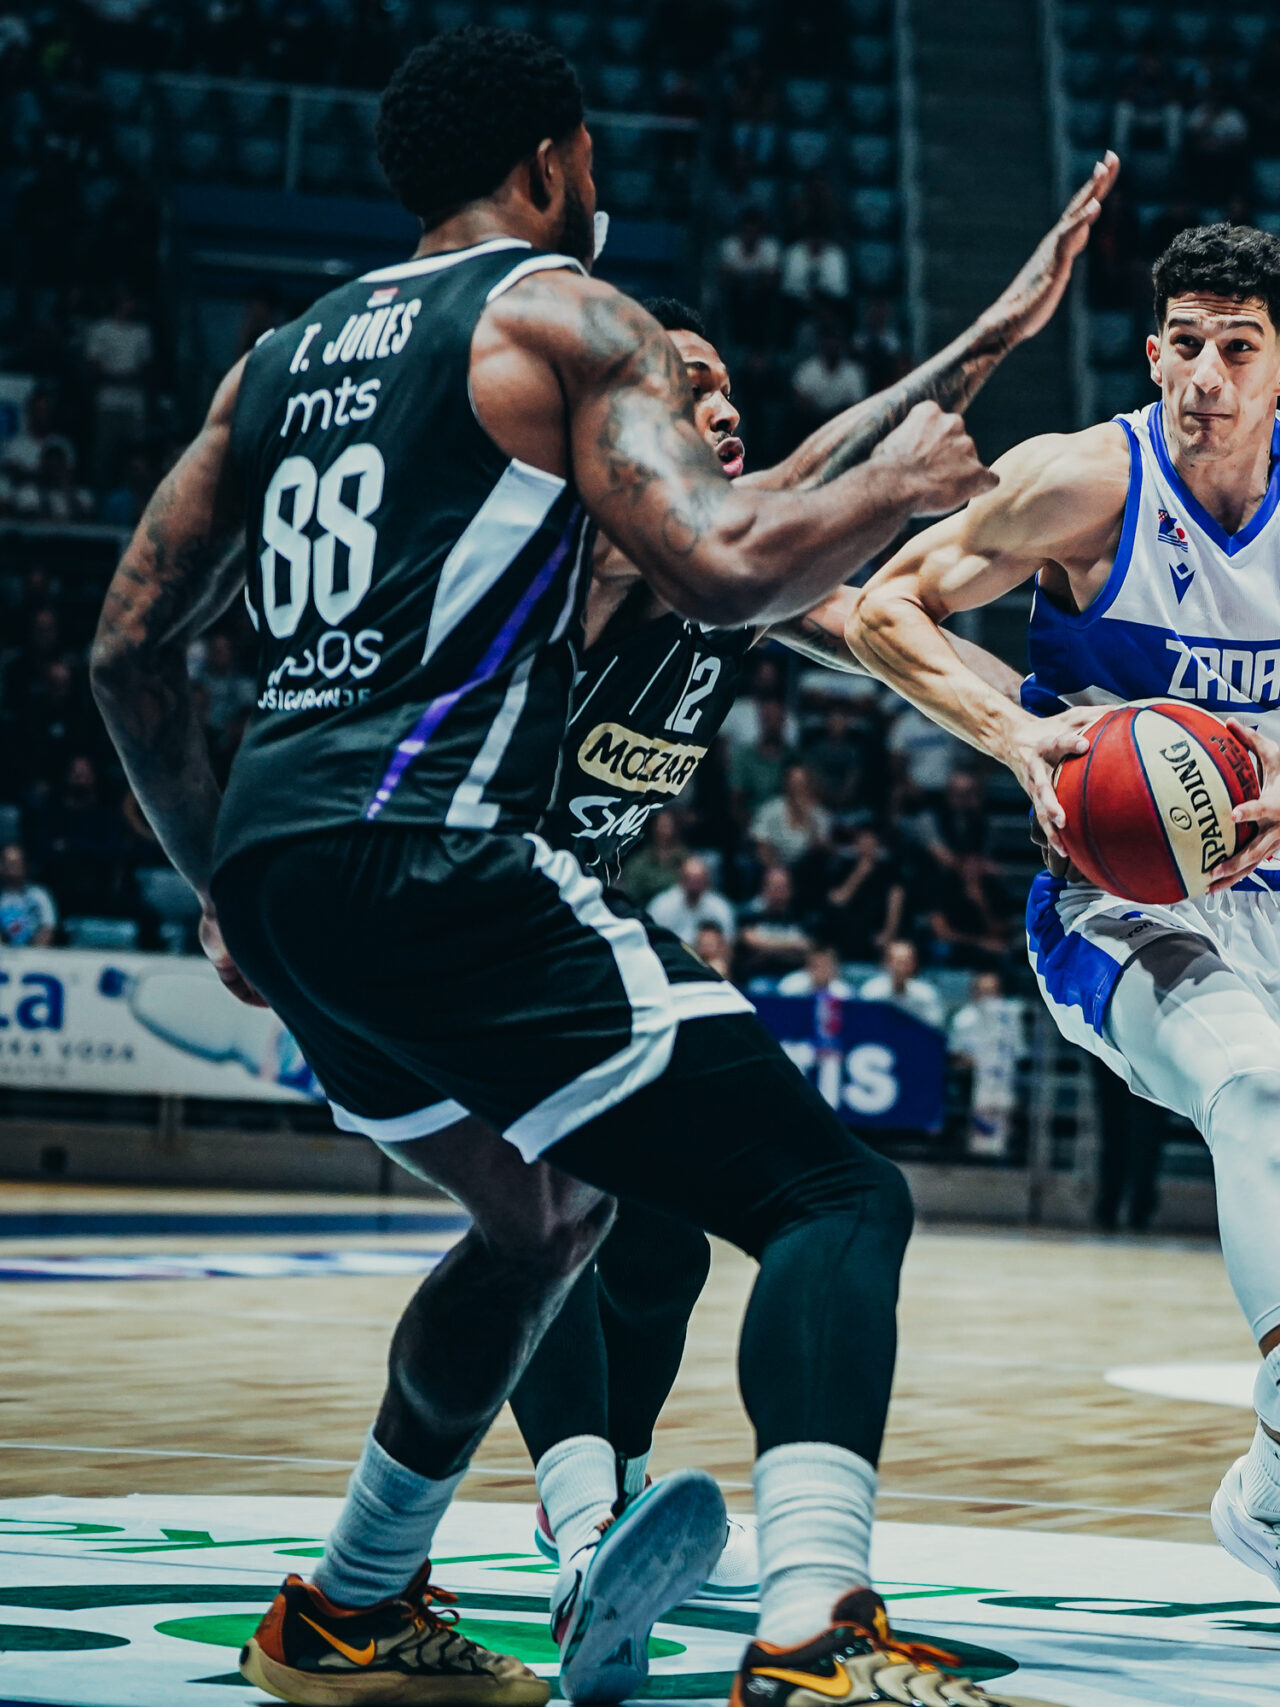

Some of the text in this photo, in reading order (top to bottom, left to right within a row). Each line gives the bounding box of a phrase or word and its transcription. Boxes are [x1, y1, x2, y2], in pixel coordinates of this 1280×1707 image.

[289, 298, 422, 374] T. JONES
[280, 376, 381, 437] mts
[260, 443, 385, 638] 88
[584, 731, 701, 786] MOZZAR
[1160, 740, 1229, 874] SPALDING
